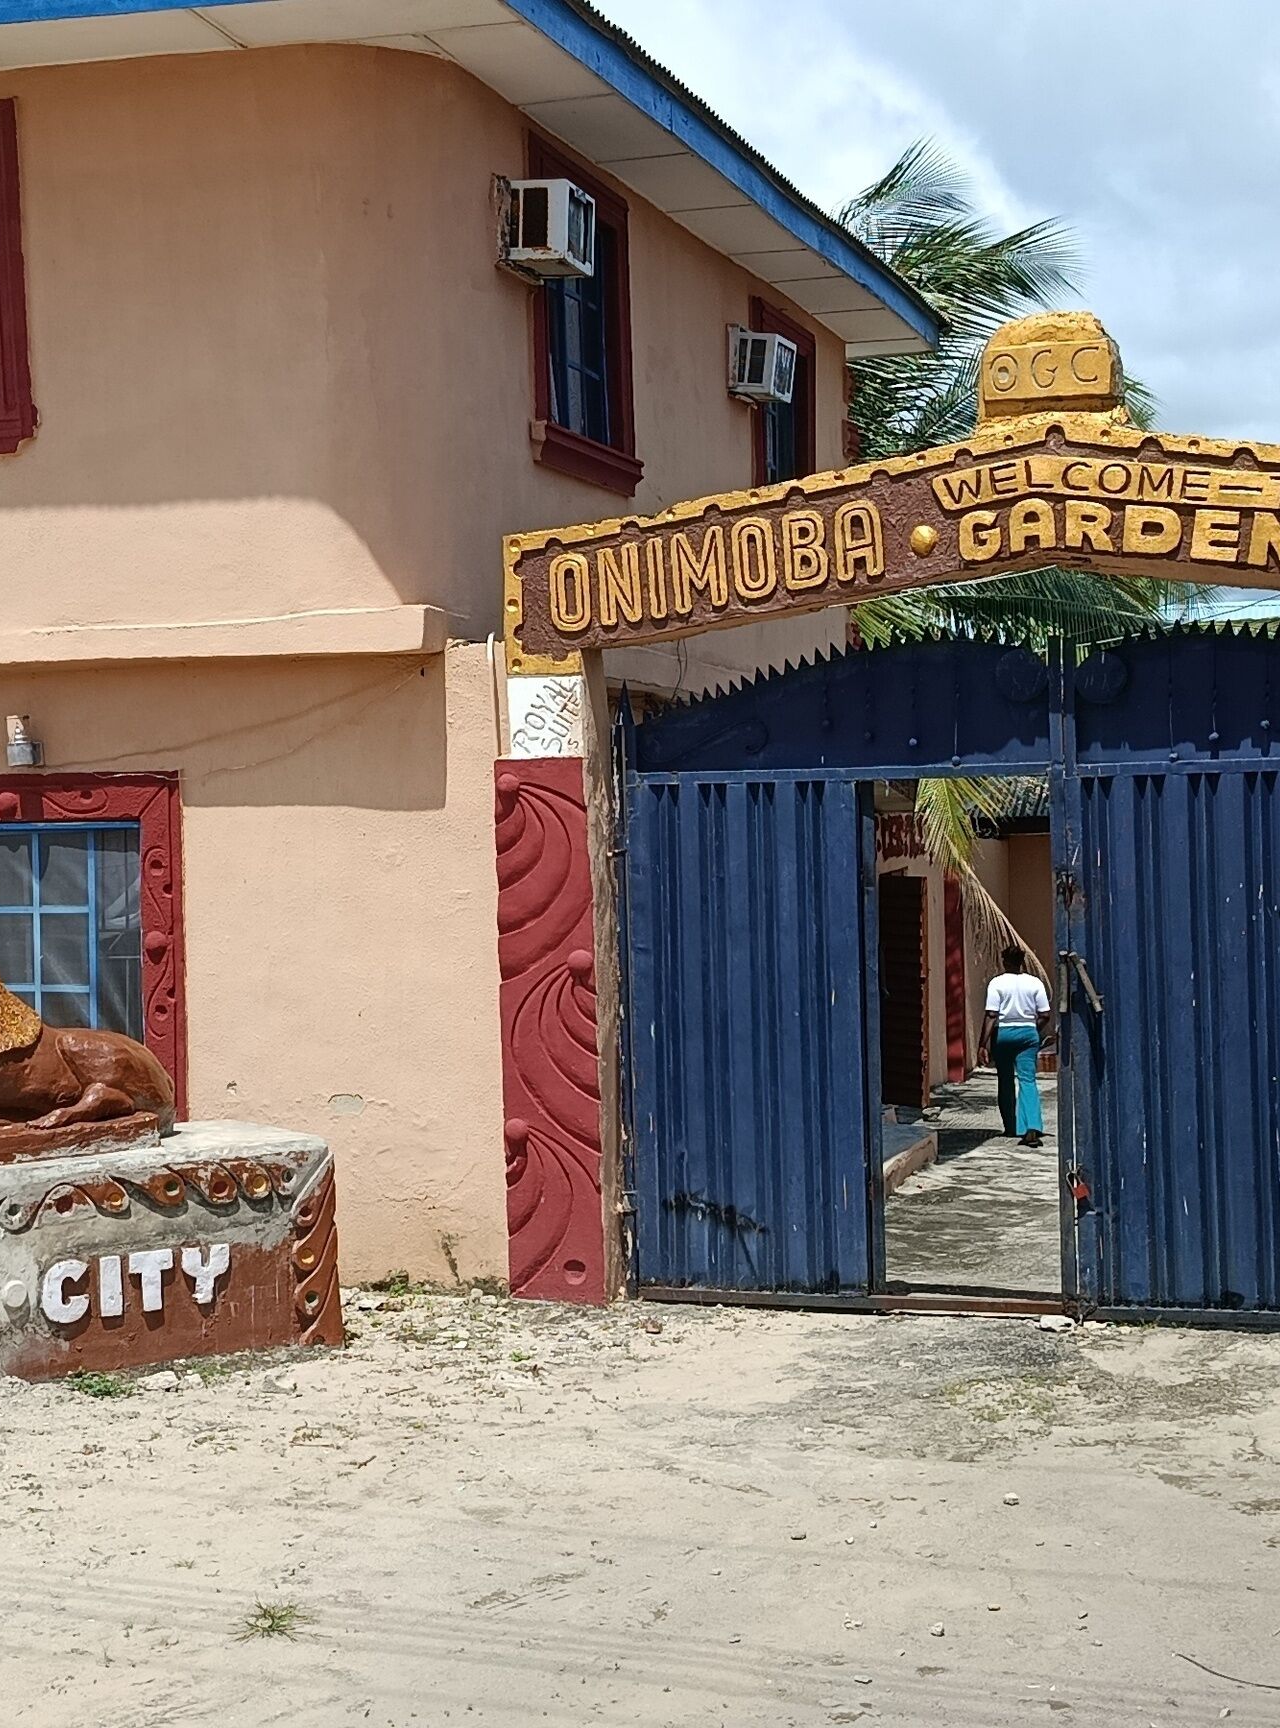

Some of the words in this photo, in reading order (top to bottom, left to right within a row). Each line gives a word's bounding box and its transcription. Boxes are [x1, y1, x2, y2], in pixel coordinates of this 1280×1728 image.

[990, 345, 1100, 393] OGC
[549, 500, 885, 632] ONIMOBA
[512, 678, 578, 753] ROYAL
[42, 1244, 230, 1323] CITY
